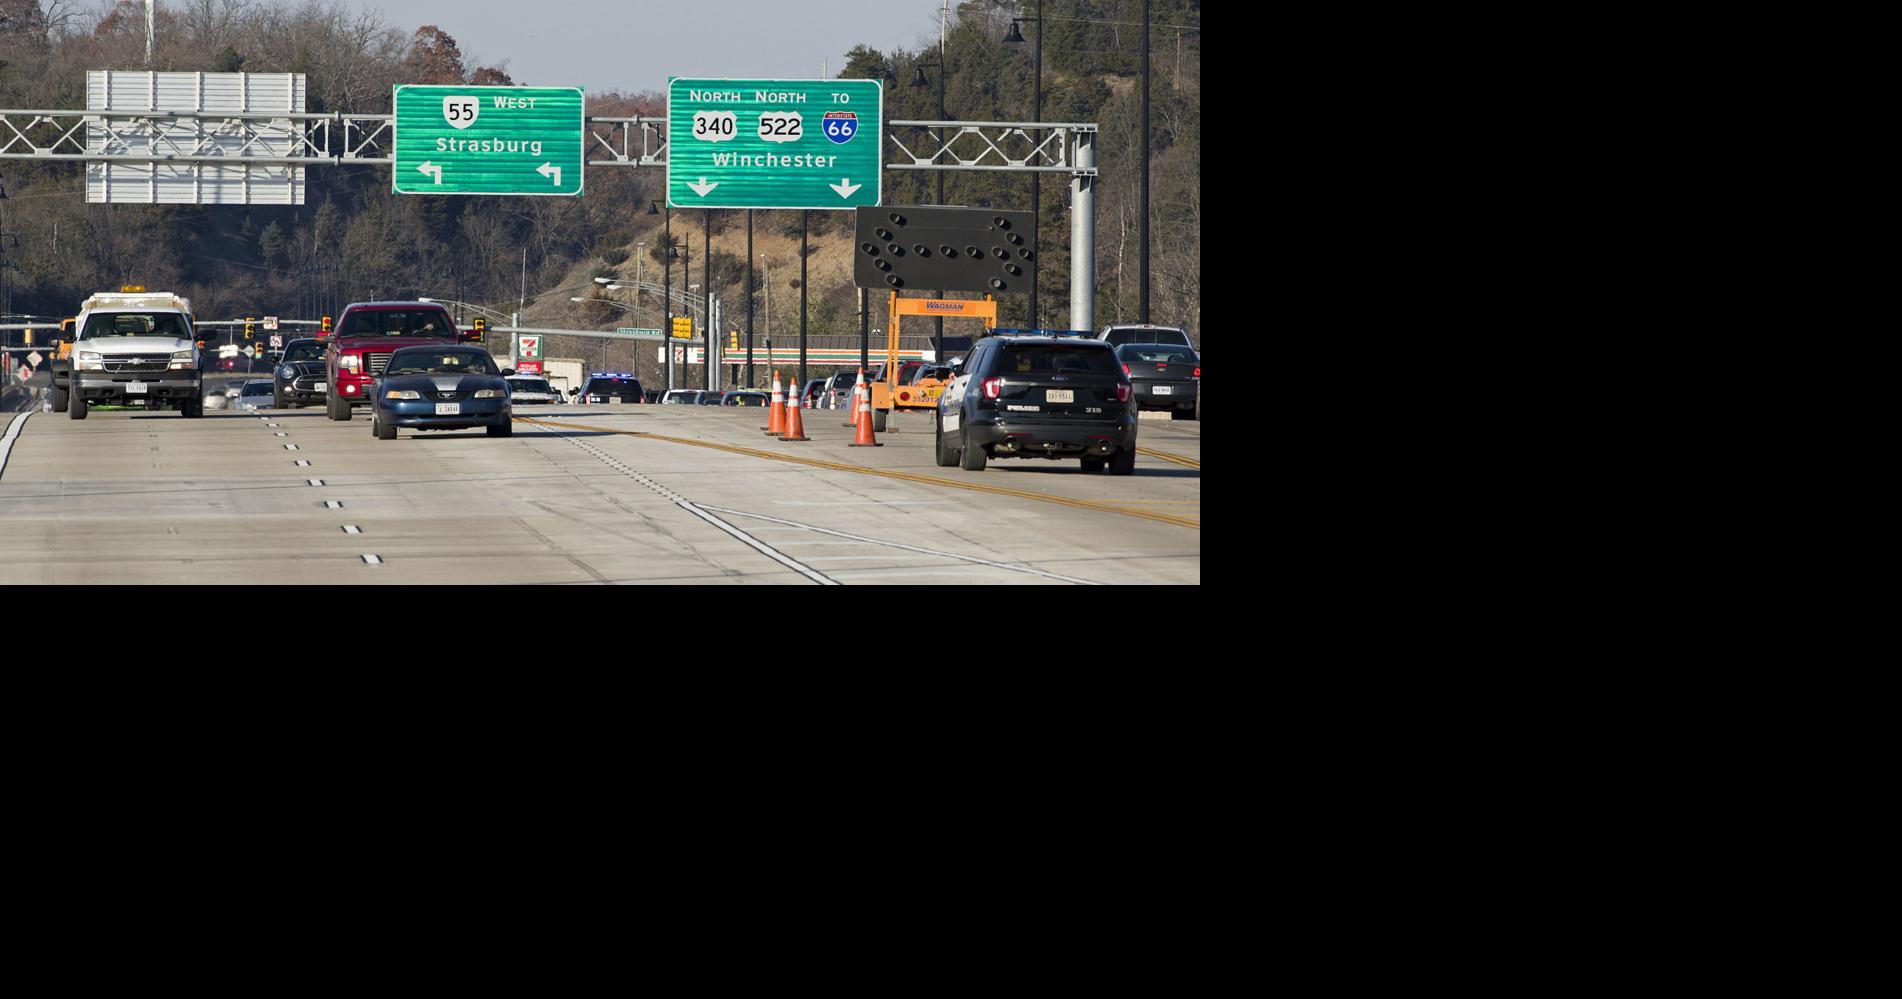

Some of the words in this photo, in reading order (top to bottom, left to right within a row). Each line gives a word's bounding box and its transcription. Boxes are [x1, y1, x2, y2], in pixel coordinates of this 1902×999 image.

[494, 96, 536, 108] WEST
[690, 90, 740, 103] NORTH
[755, 90, 806, 103] NORTH
[831, 93, 849, 104] TO
[449, 103, 473, 121] 55
[696, 117, 733, 135] 340
[761, 118, 801, 136] 522
[828, 121, 852, 136] 66
[436, 137, 542, 156] Strasburg
[712, 152, 837, 168] Winchester
[926, 301, 964, 310] WAGMAN
[1006, 404, 1040, 412] POLICE
